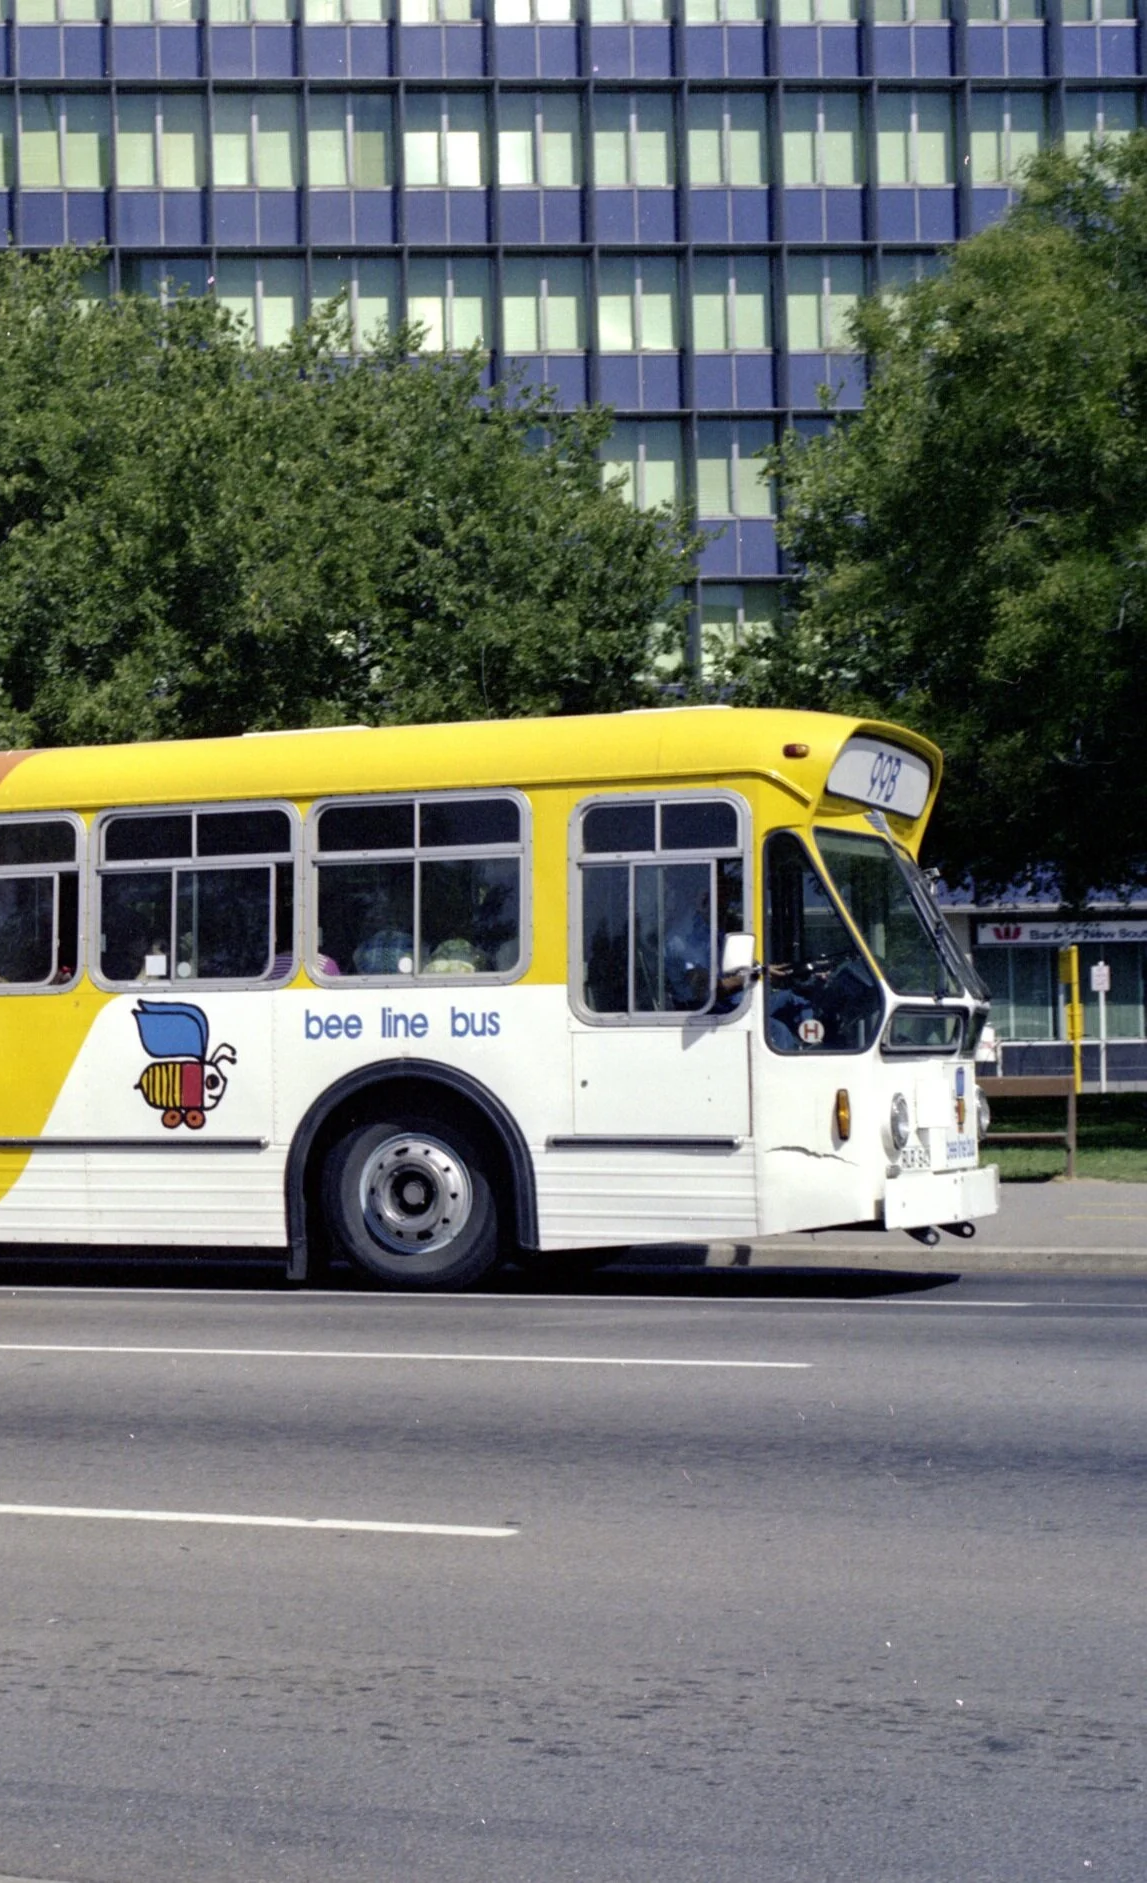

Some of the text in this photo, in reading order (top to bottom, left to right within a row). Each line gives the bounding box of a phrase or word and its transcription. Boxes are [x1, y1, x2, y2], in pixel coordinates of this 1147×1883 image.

[305, 1006, 501, 1040] bee line bus
[804, 1023, 819, 1040] H
